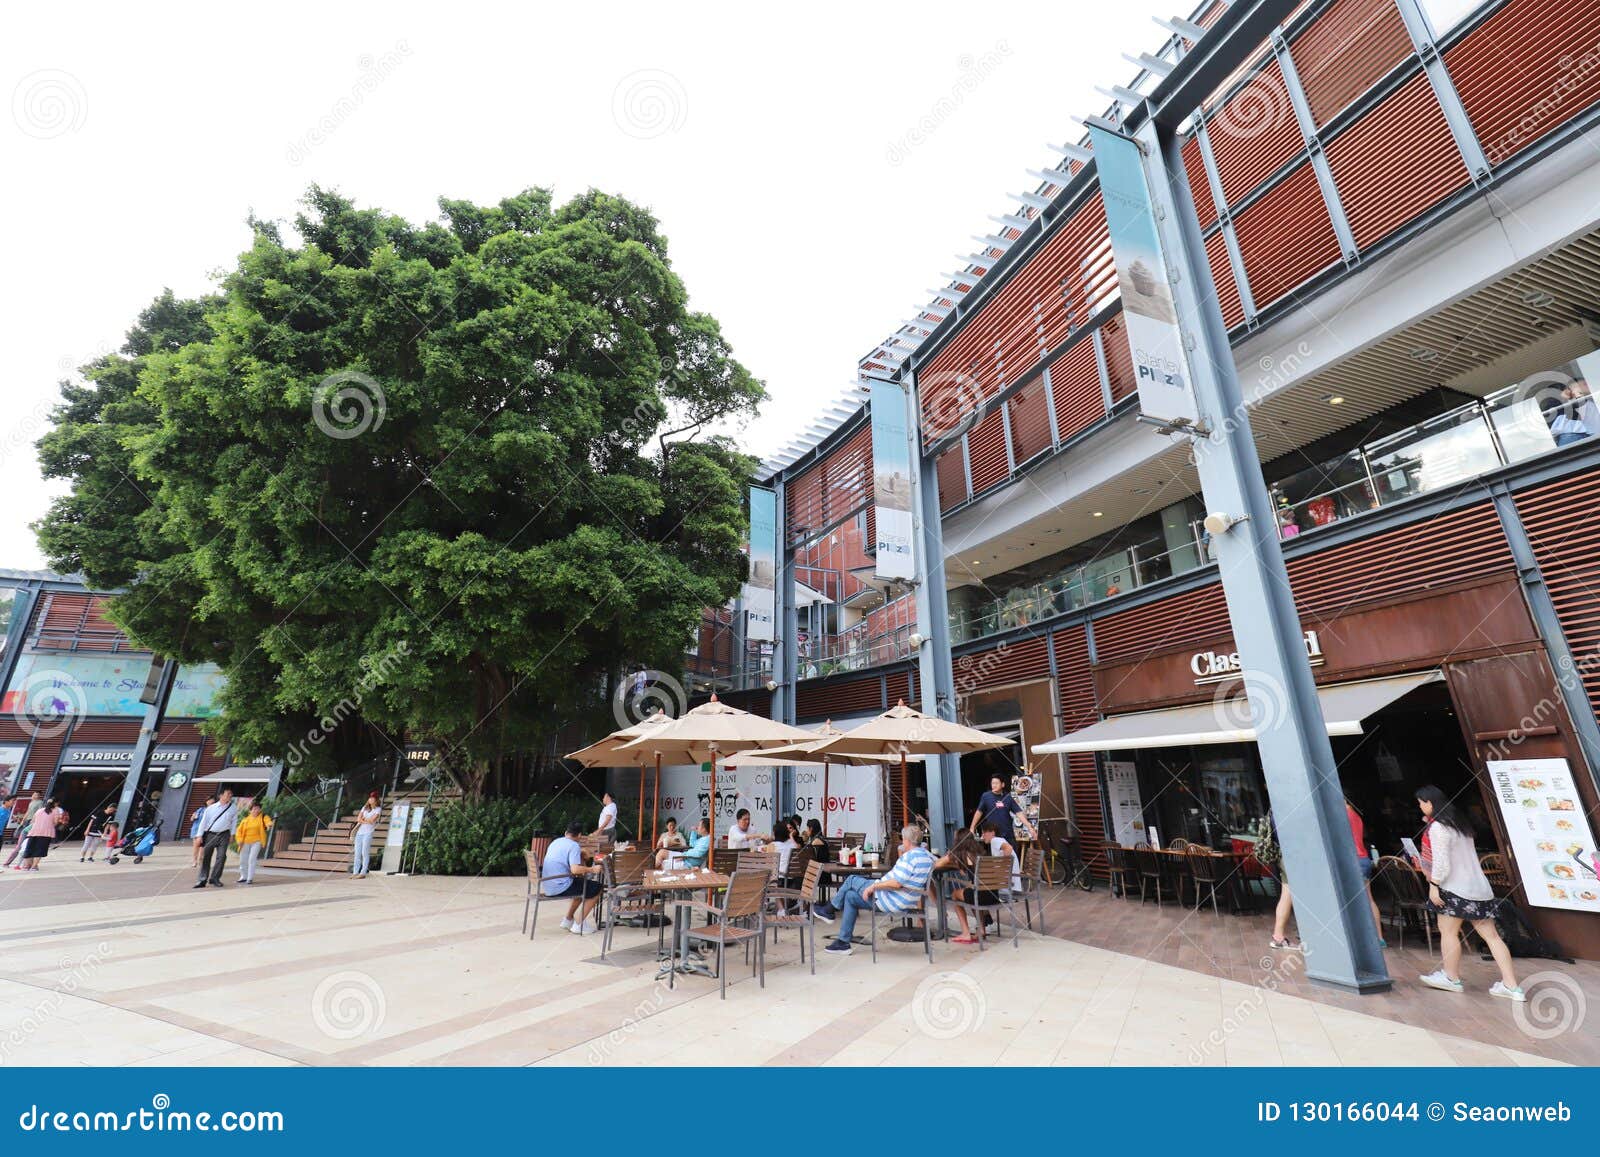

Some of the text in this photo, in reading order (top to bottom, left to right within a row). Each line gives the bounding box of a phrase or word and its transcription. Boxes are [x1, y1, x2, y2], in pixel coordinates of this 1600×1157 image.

[72, 752, 189, 761] STARBUCK OFFEE
[821, 797, 856, 812] LOVE
